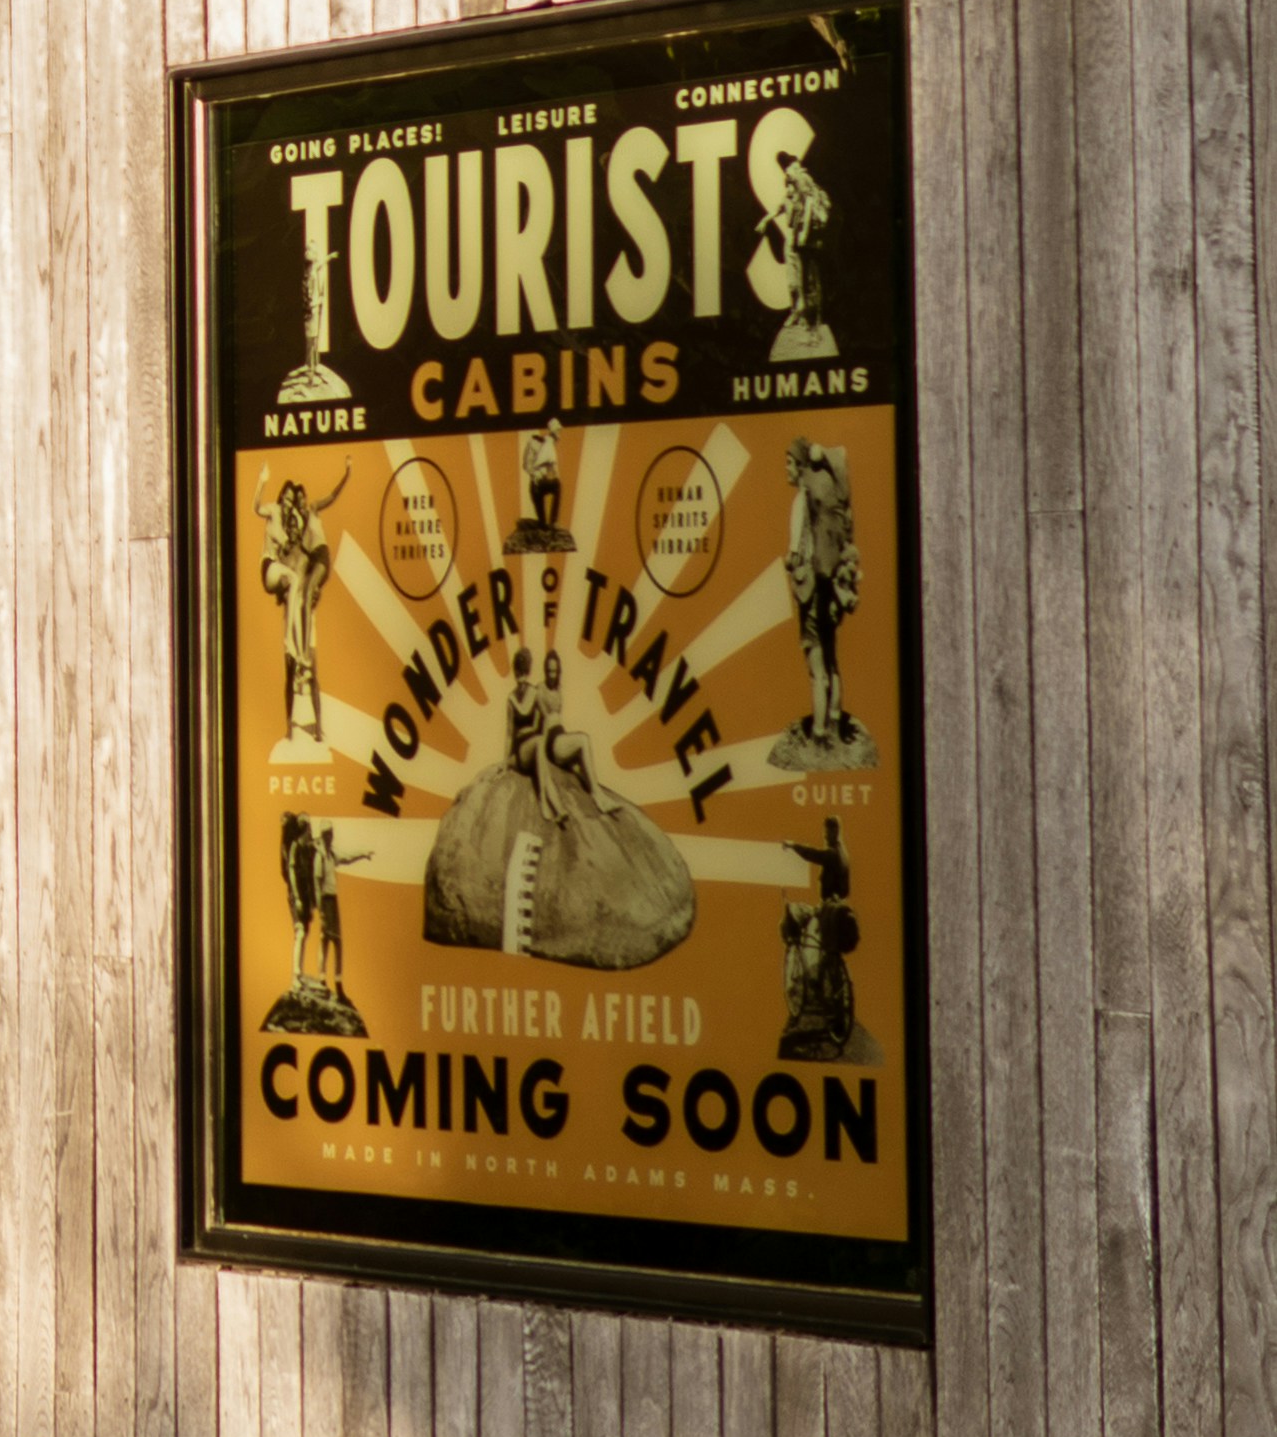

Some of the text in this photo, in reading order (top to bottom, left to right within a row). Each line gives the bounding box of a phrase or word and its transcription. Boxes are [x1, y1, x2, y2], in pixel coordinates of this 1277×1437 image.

[676, 69, 840, 109] CONNECTION
[498, 104, 597, 136] LEISURE
[270, 123, 442, 164] GOING PLACES!
[290, 107, 816, 353] TOURISTS
[411, 341, 680, 422] CABINS
[733, 368, 869, 401] HUMANS
[264, 407, 367, 437] NATURE
[403, 495, 434, 510] WHEN
[658, 485, 703, 502] HUMAN
[396, 519, 442, 535] NATURE
[653, 511, 708, 528] SPIRITS
[393, 543, 445, 560] THRIVES
[652, 537, 709, 554] VIBRATE
[362, 567, 734, 825] WONDER OF TRAVEL
[269, 775, 336, 795] PEACE
[792, 784, 872, 806] QUIET
[420, 984, 703, 1046] FURTHER AFIELD
[260, 1043, 878, 1164] COMING SOON
[322, 1142, 815, 1200] MADE IN NORTH ADAMS MASS.
